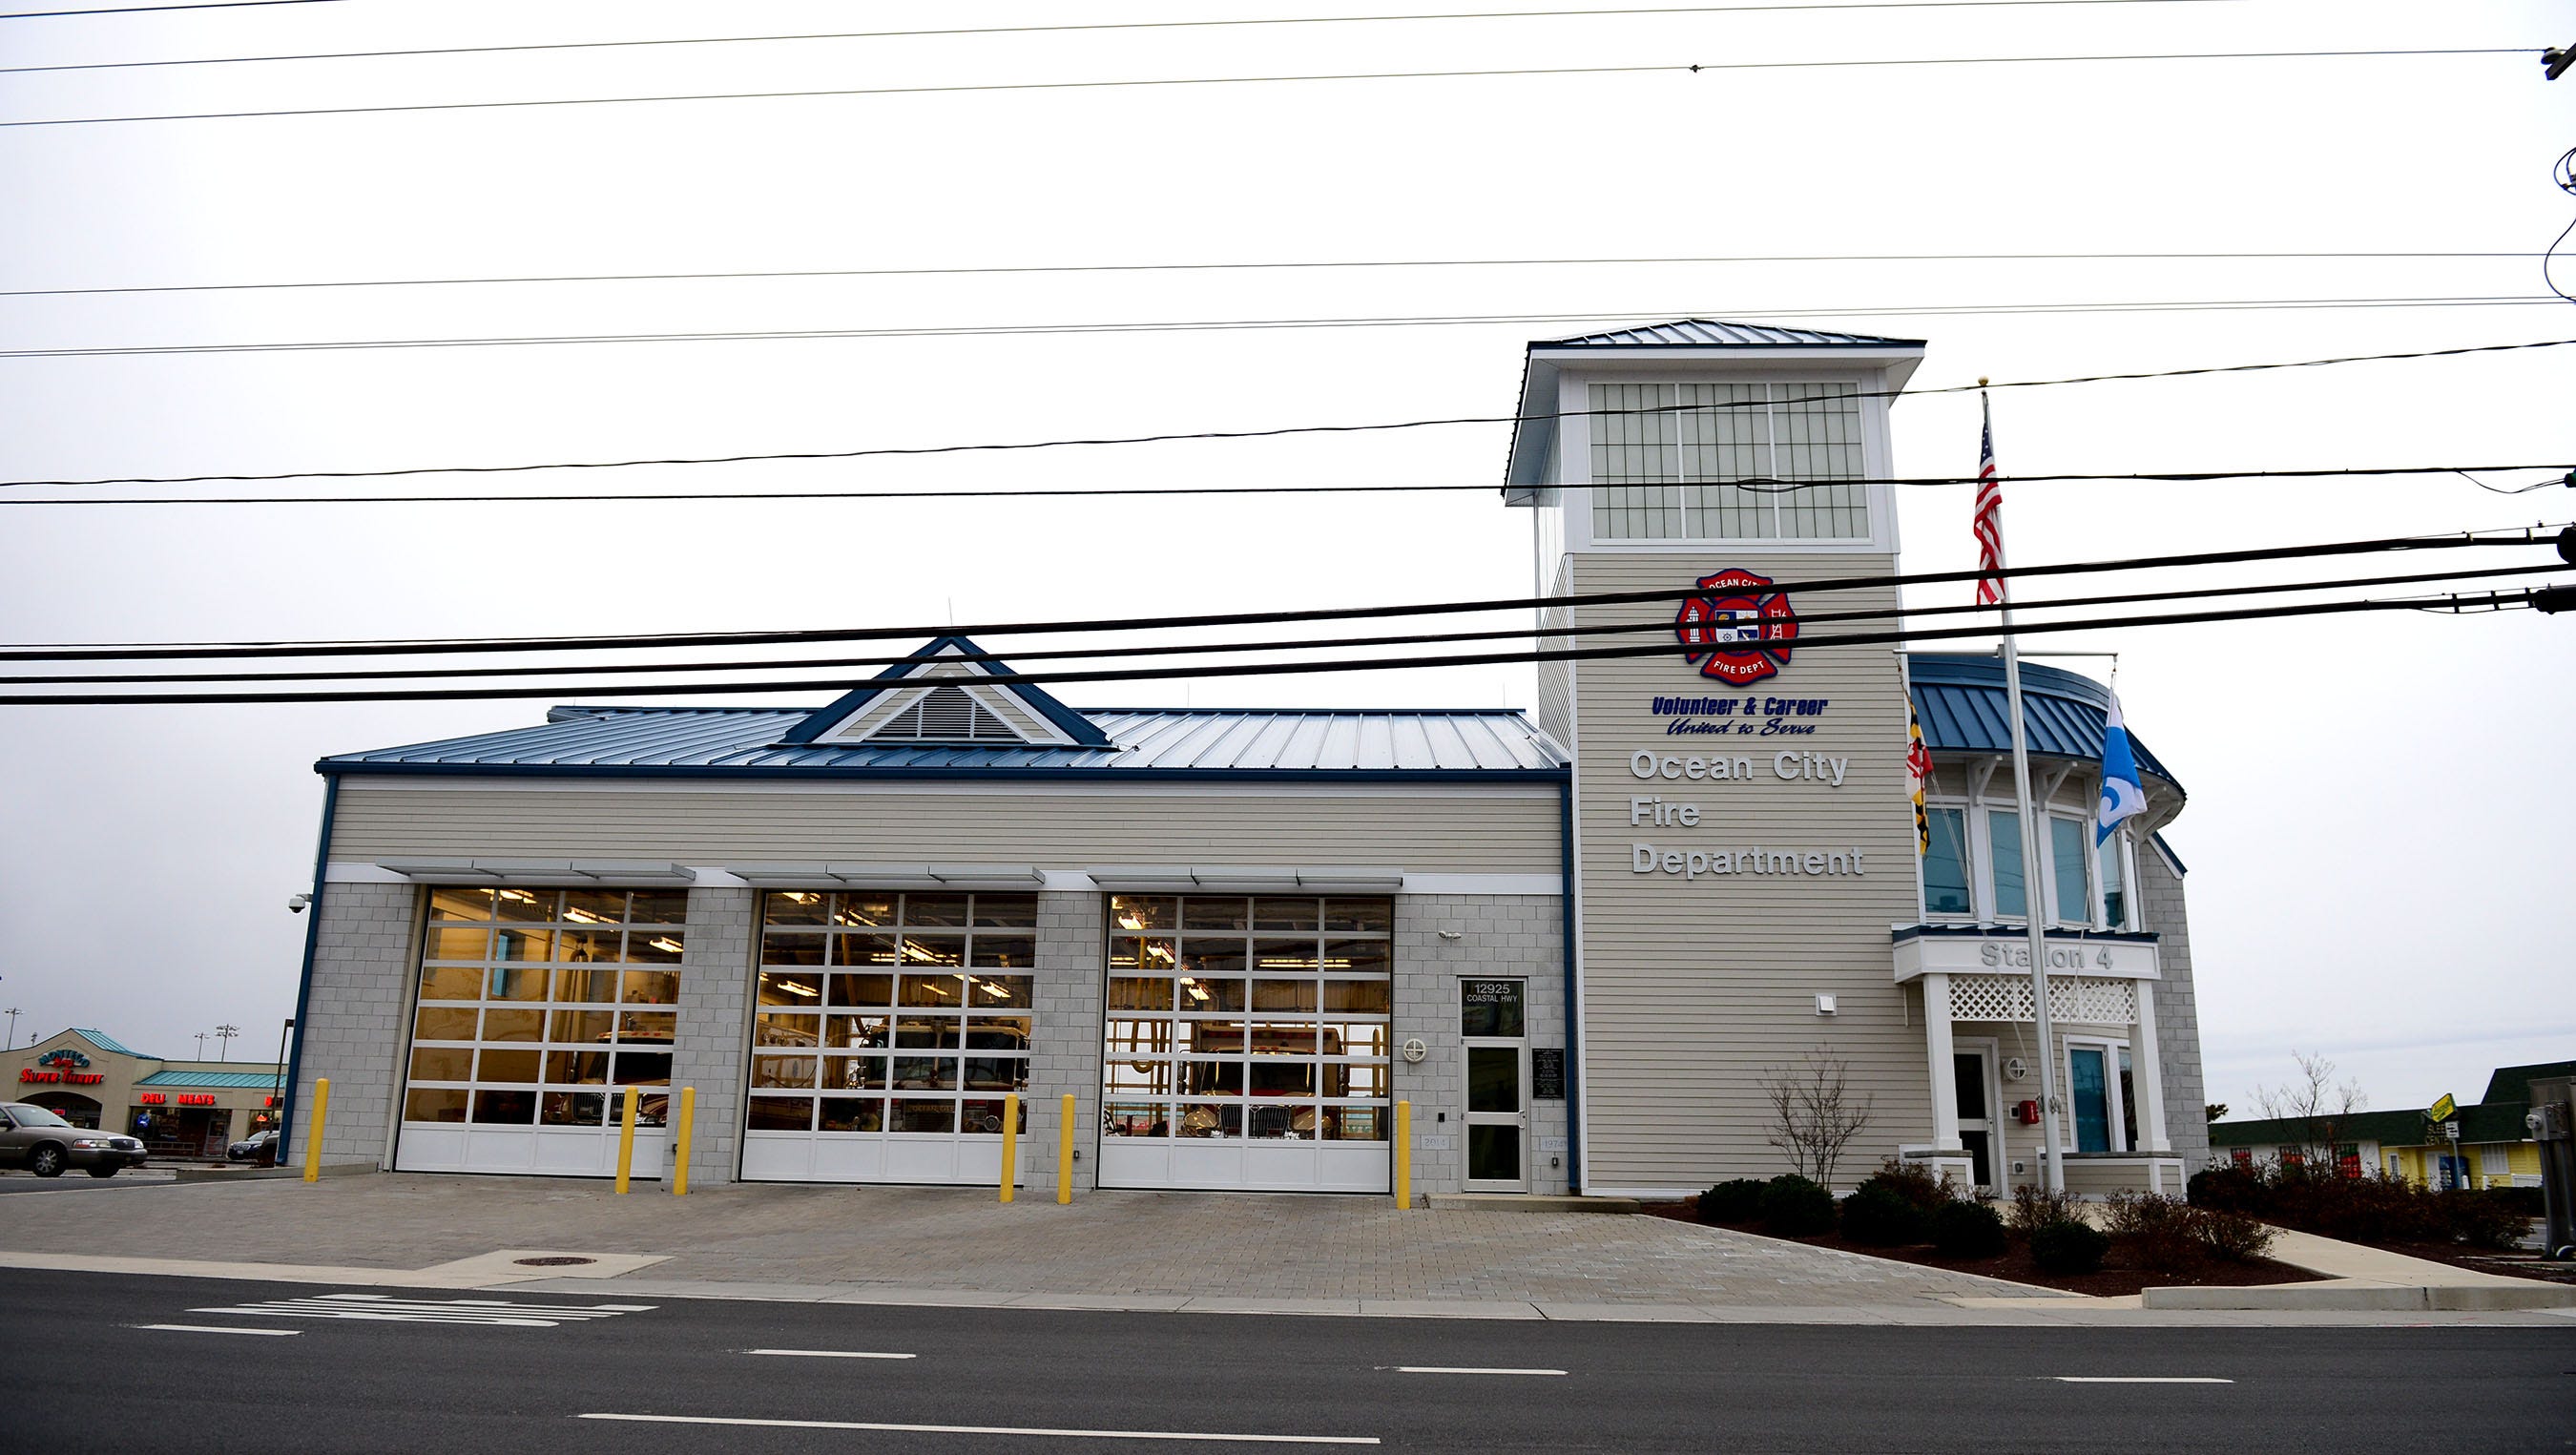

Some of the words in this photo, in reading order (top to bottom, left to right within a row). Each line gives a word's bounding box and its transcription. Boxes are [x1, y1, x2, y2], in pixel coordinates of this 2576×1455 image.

[1709, 578, 1739, 590] OCEAN
[1741, 578, 1762, 589] CIT
[1714, 660, 1735, 674] FIRE
[1739, 660, 1764, 675] DEPT
[1652, 696, 1739, 716] Volunteer
[1743, 697, 1757, 716] &
[1763, 697, 1829, 716] Career
[1666, 717, 1735, 736] United
[1737, 722, 1755, 735] to
[1759, 717, 1816, 737] Serve
[1630, 749, 1754, 780] Ocean
[1773, 750, 1849, 786] City
[1630, 796, 1701, 827] Fire
[1631, 842, 1864, 881] Department
[1981, 941, 2086, 968] Staion
[2096, 946, 2114, 969] 4
[1466, 994, 1499, 1003] COASTAL
[1501, 994, 1518, 1003] HWY
[1475, 984, 1510, 994] 12925
[140, 1092, 167, 1105] DELI
[177, 1093, 216, 1106] MEATS
